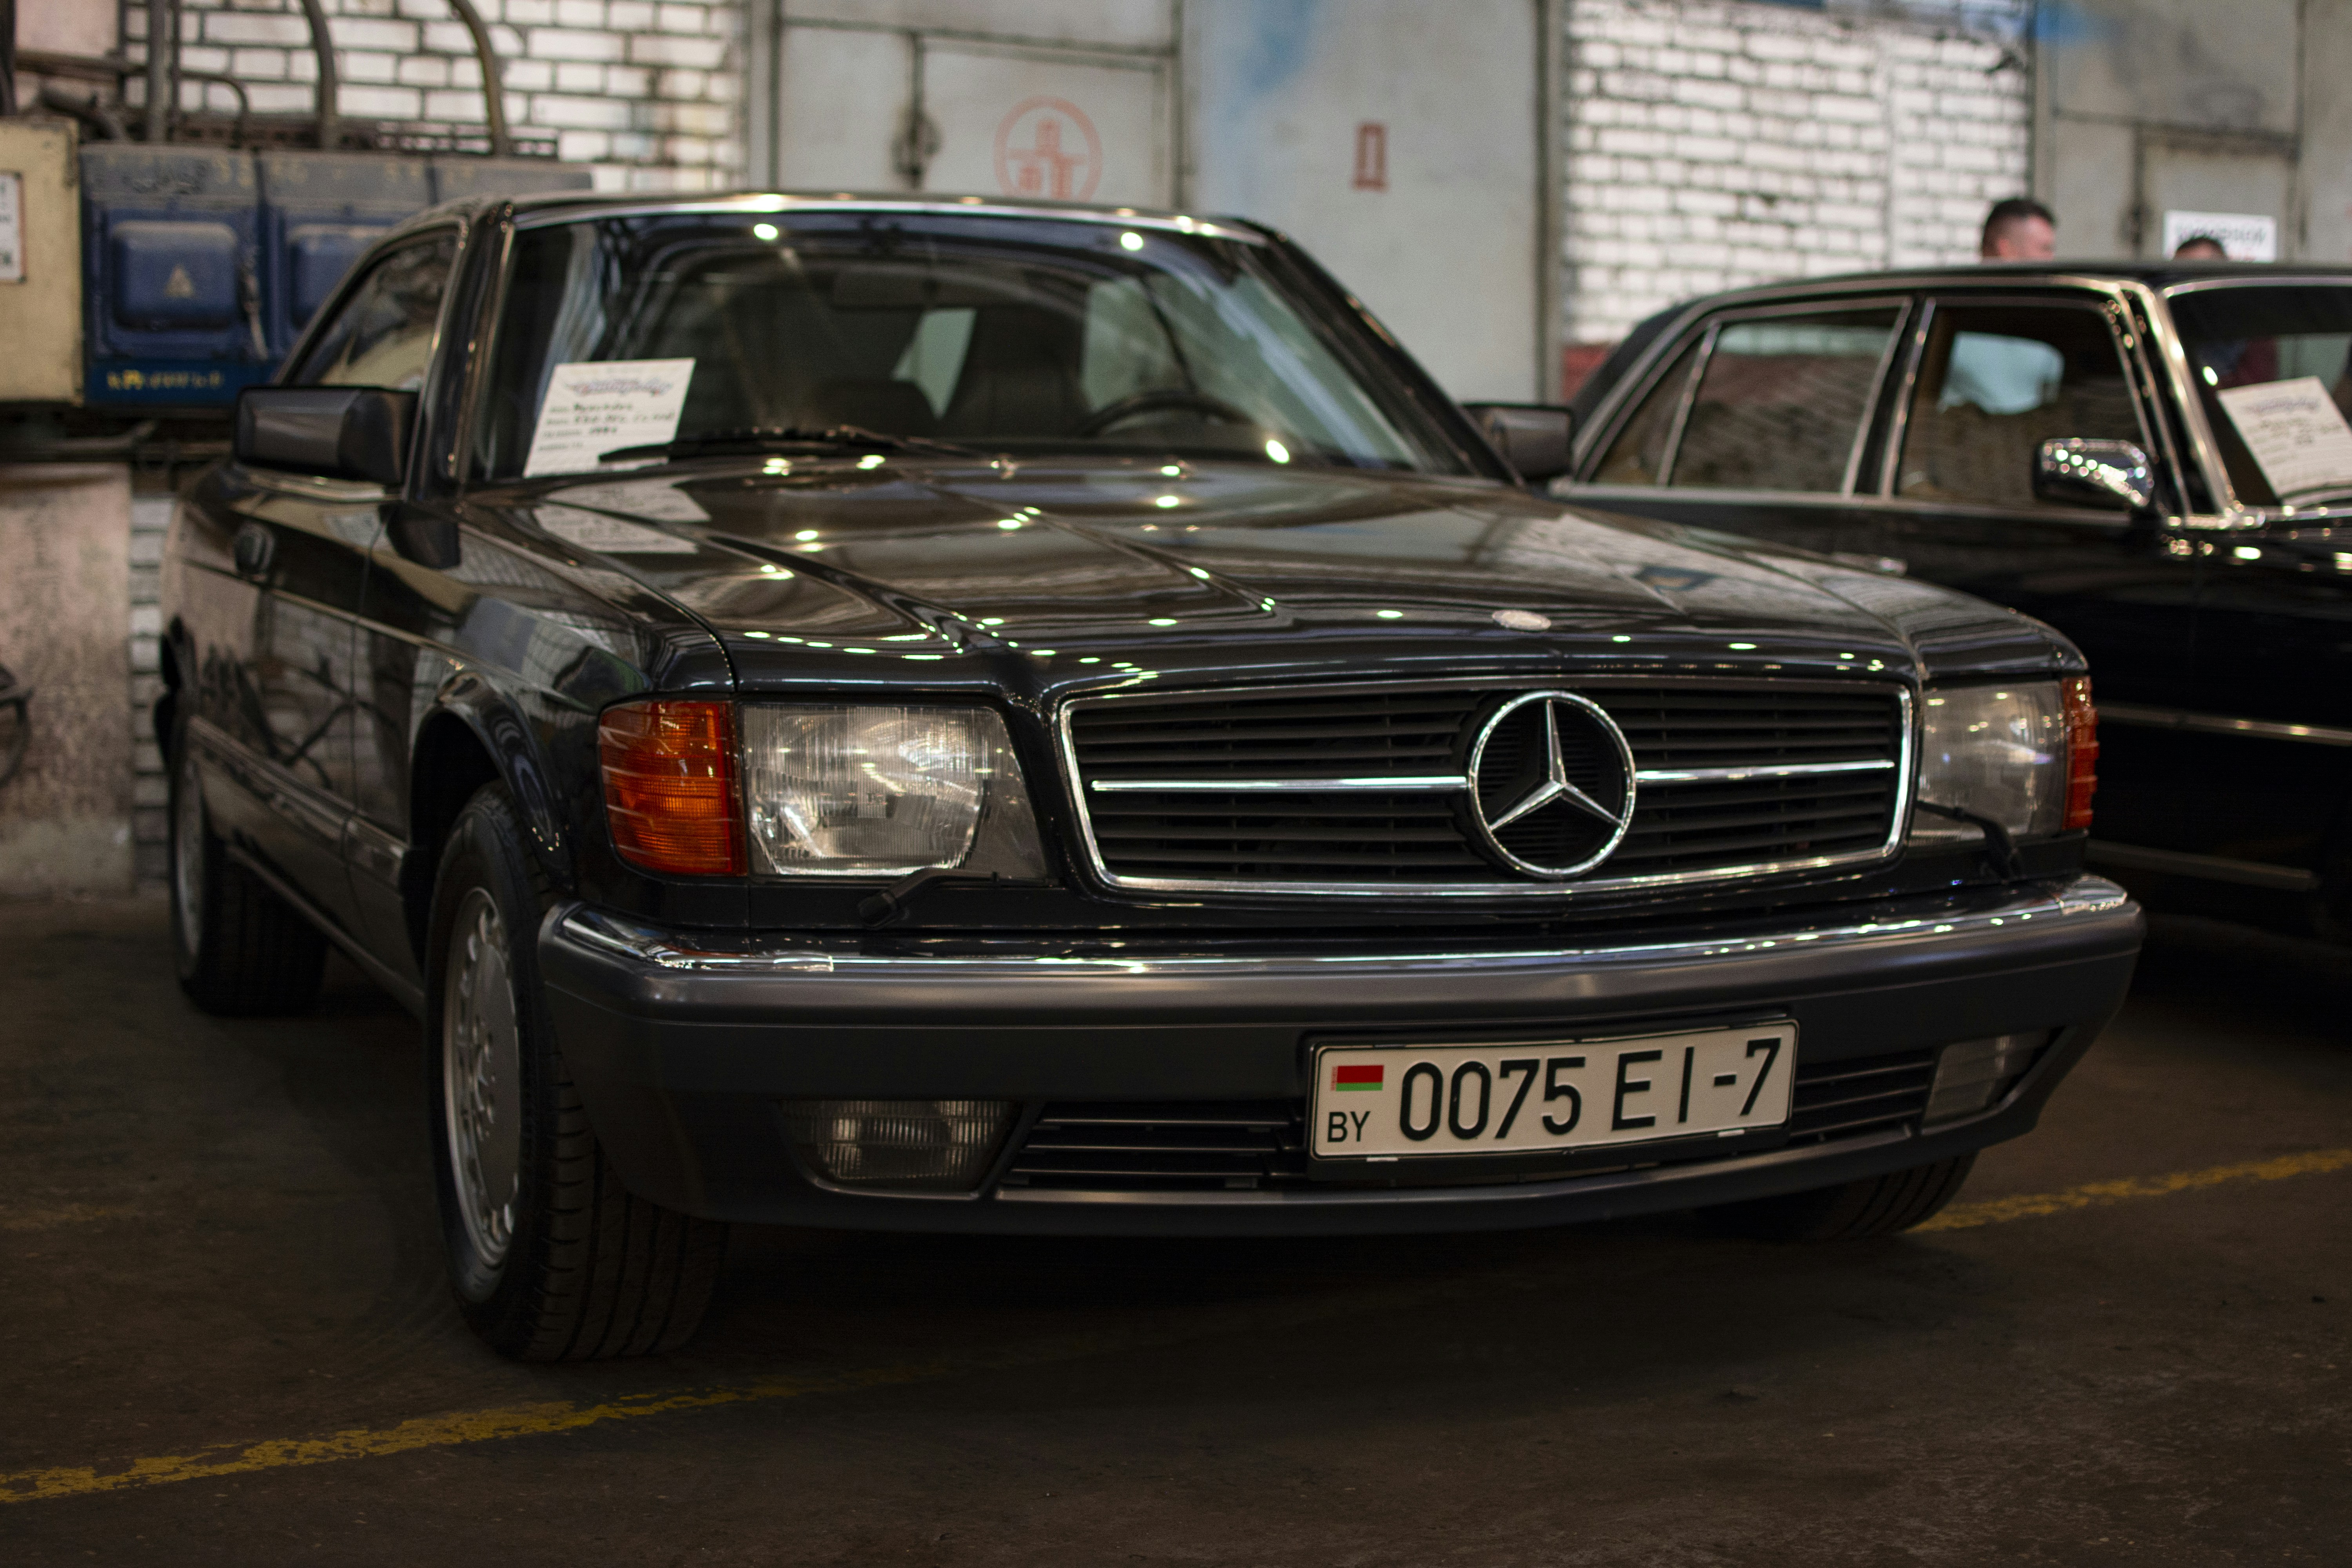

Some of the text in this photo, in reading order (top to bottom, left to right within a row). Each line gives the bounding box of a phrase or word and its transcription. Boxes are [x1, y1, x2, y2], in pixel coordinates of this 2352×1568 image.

[1399, 1037, 1781, 1142] 0075 EI-7
[1327, 1111, 1371, 1142] BY
